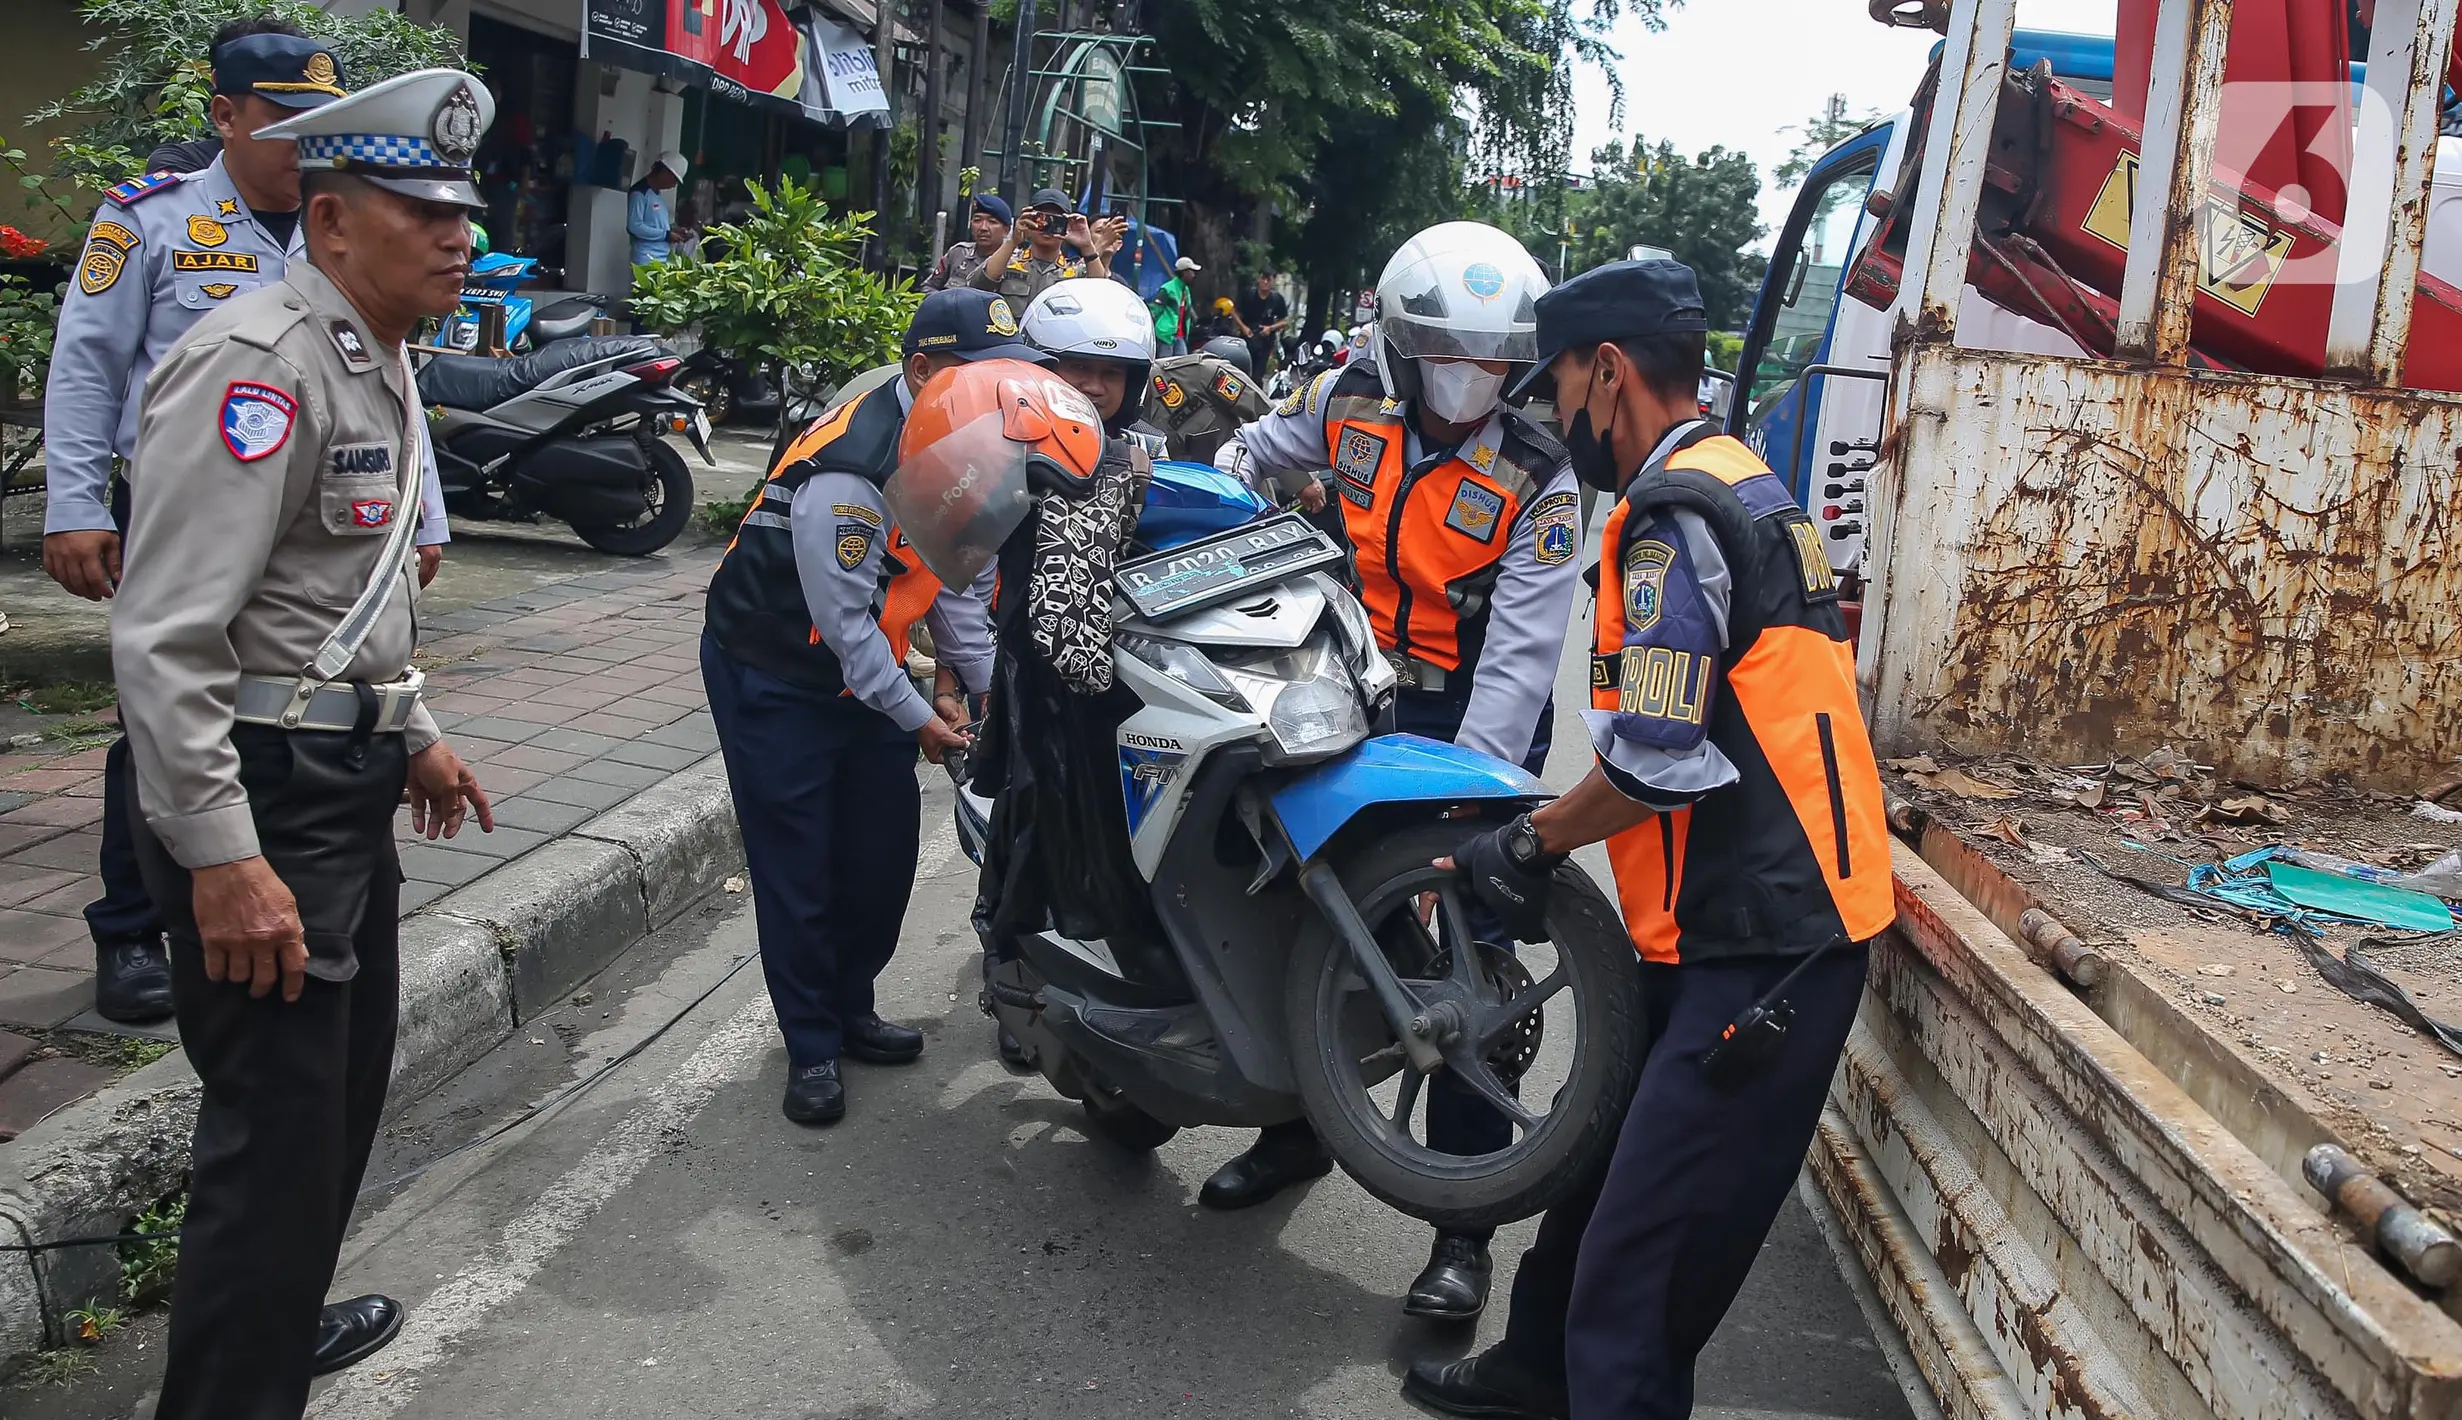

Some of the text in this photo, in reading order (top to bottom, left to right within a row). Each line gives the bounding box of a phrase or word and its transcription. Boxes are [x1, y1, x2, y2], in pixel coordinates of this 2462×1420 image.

[182, 254, 249, 269] AJAR
[233, 385, 293, 411] LALU LINTAS
[1337, 460, 1370, 483] DISHUB
[1460, 489, 1498, 514] DISHUB
[1790, 522, 1836, 592] DIS
[1125, 733, 1184, 751] HONDA
